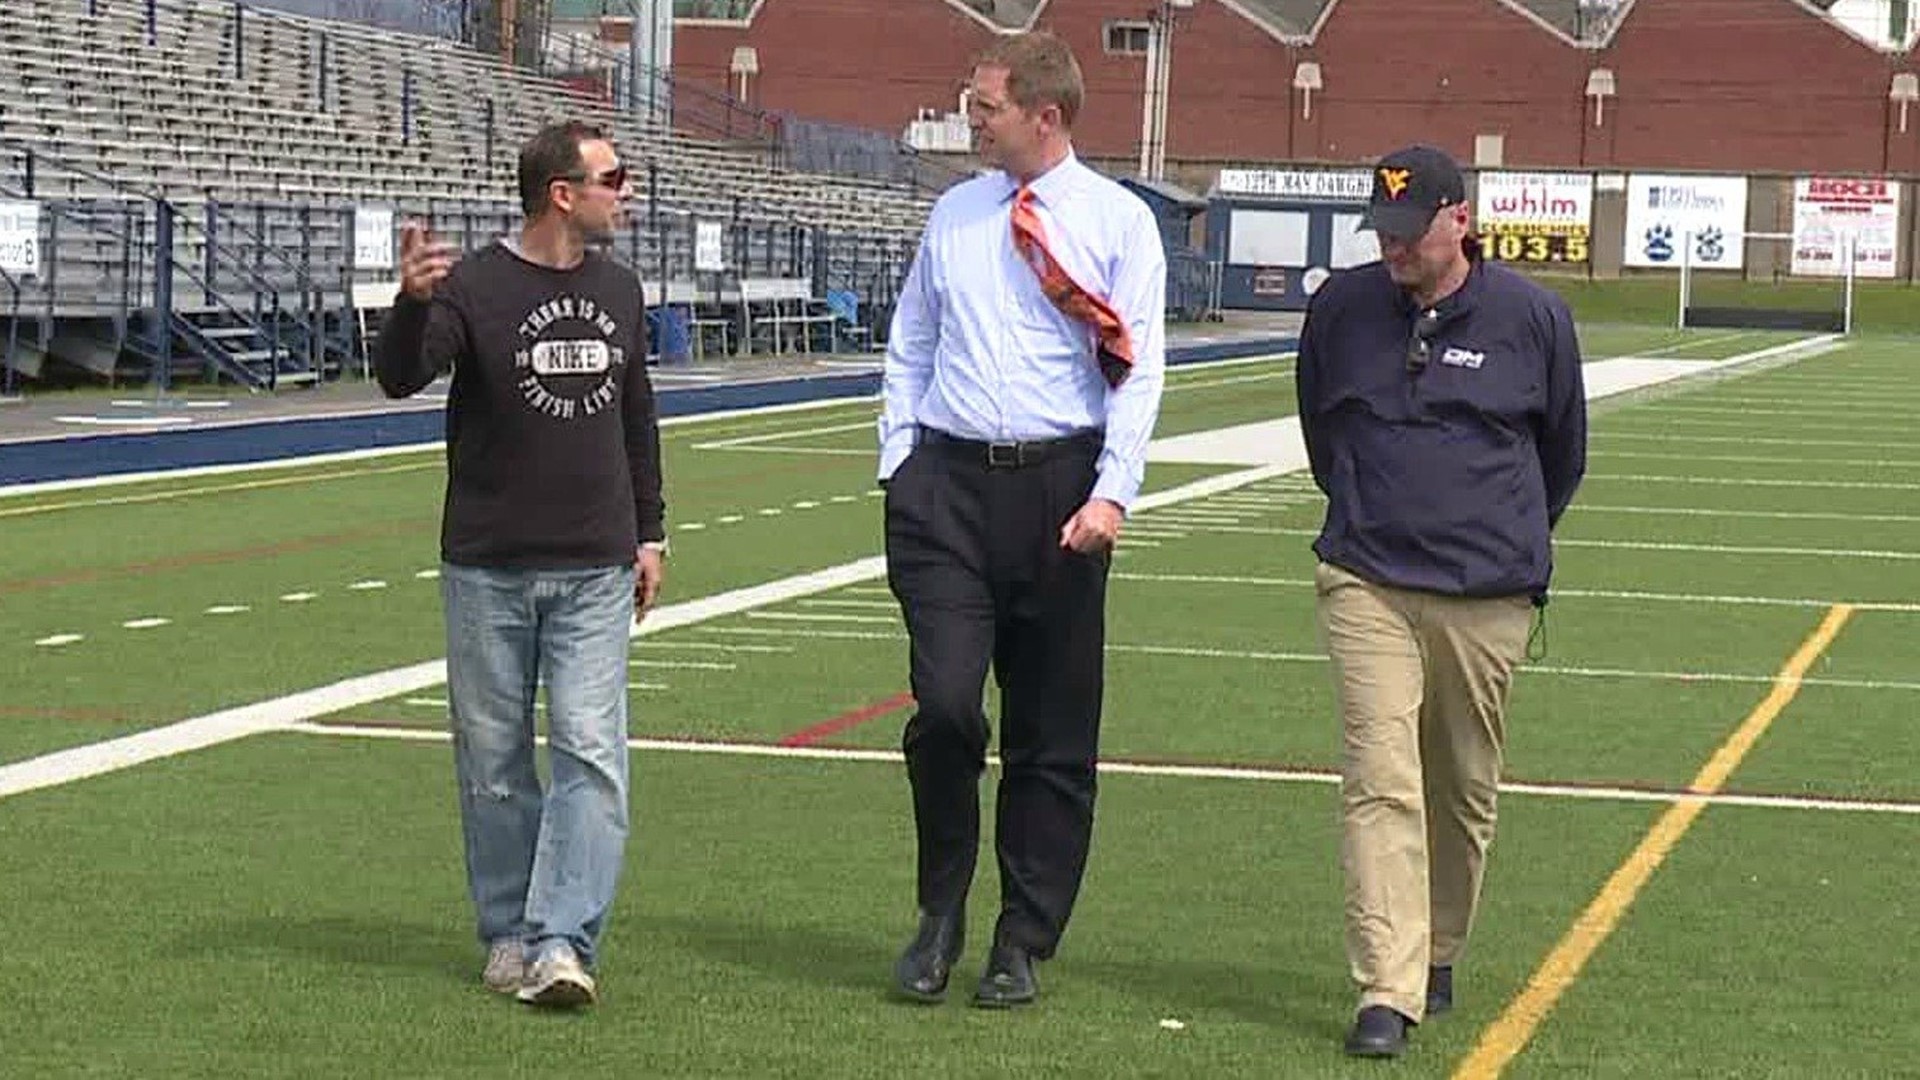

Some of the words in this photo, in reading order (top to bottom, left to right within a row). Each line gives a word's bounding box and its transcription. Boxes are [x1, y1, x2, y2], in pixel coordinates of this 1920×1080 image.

[1316, 173, 1371, 194] DAWGH
[1478, 235, 1588, 260] 103.5
[518, 298, 575, 338] THERE
[578, 298, 595, 320] IS
[596, 311, 616, 337] NO
[549, 344, 600, 369] NIKE
[518, 376, 575, 418] FINISH
